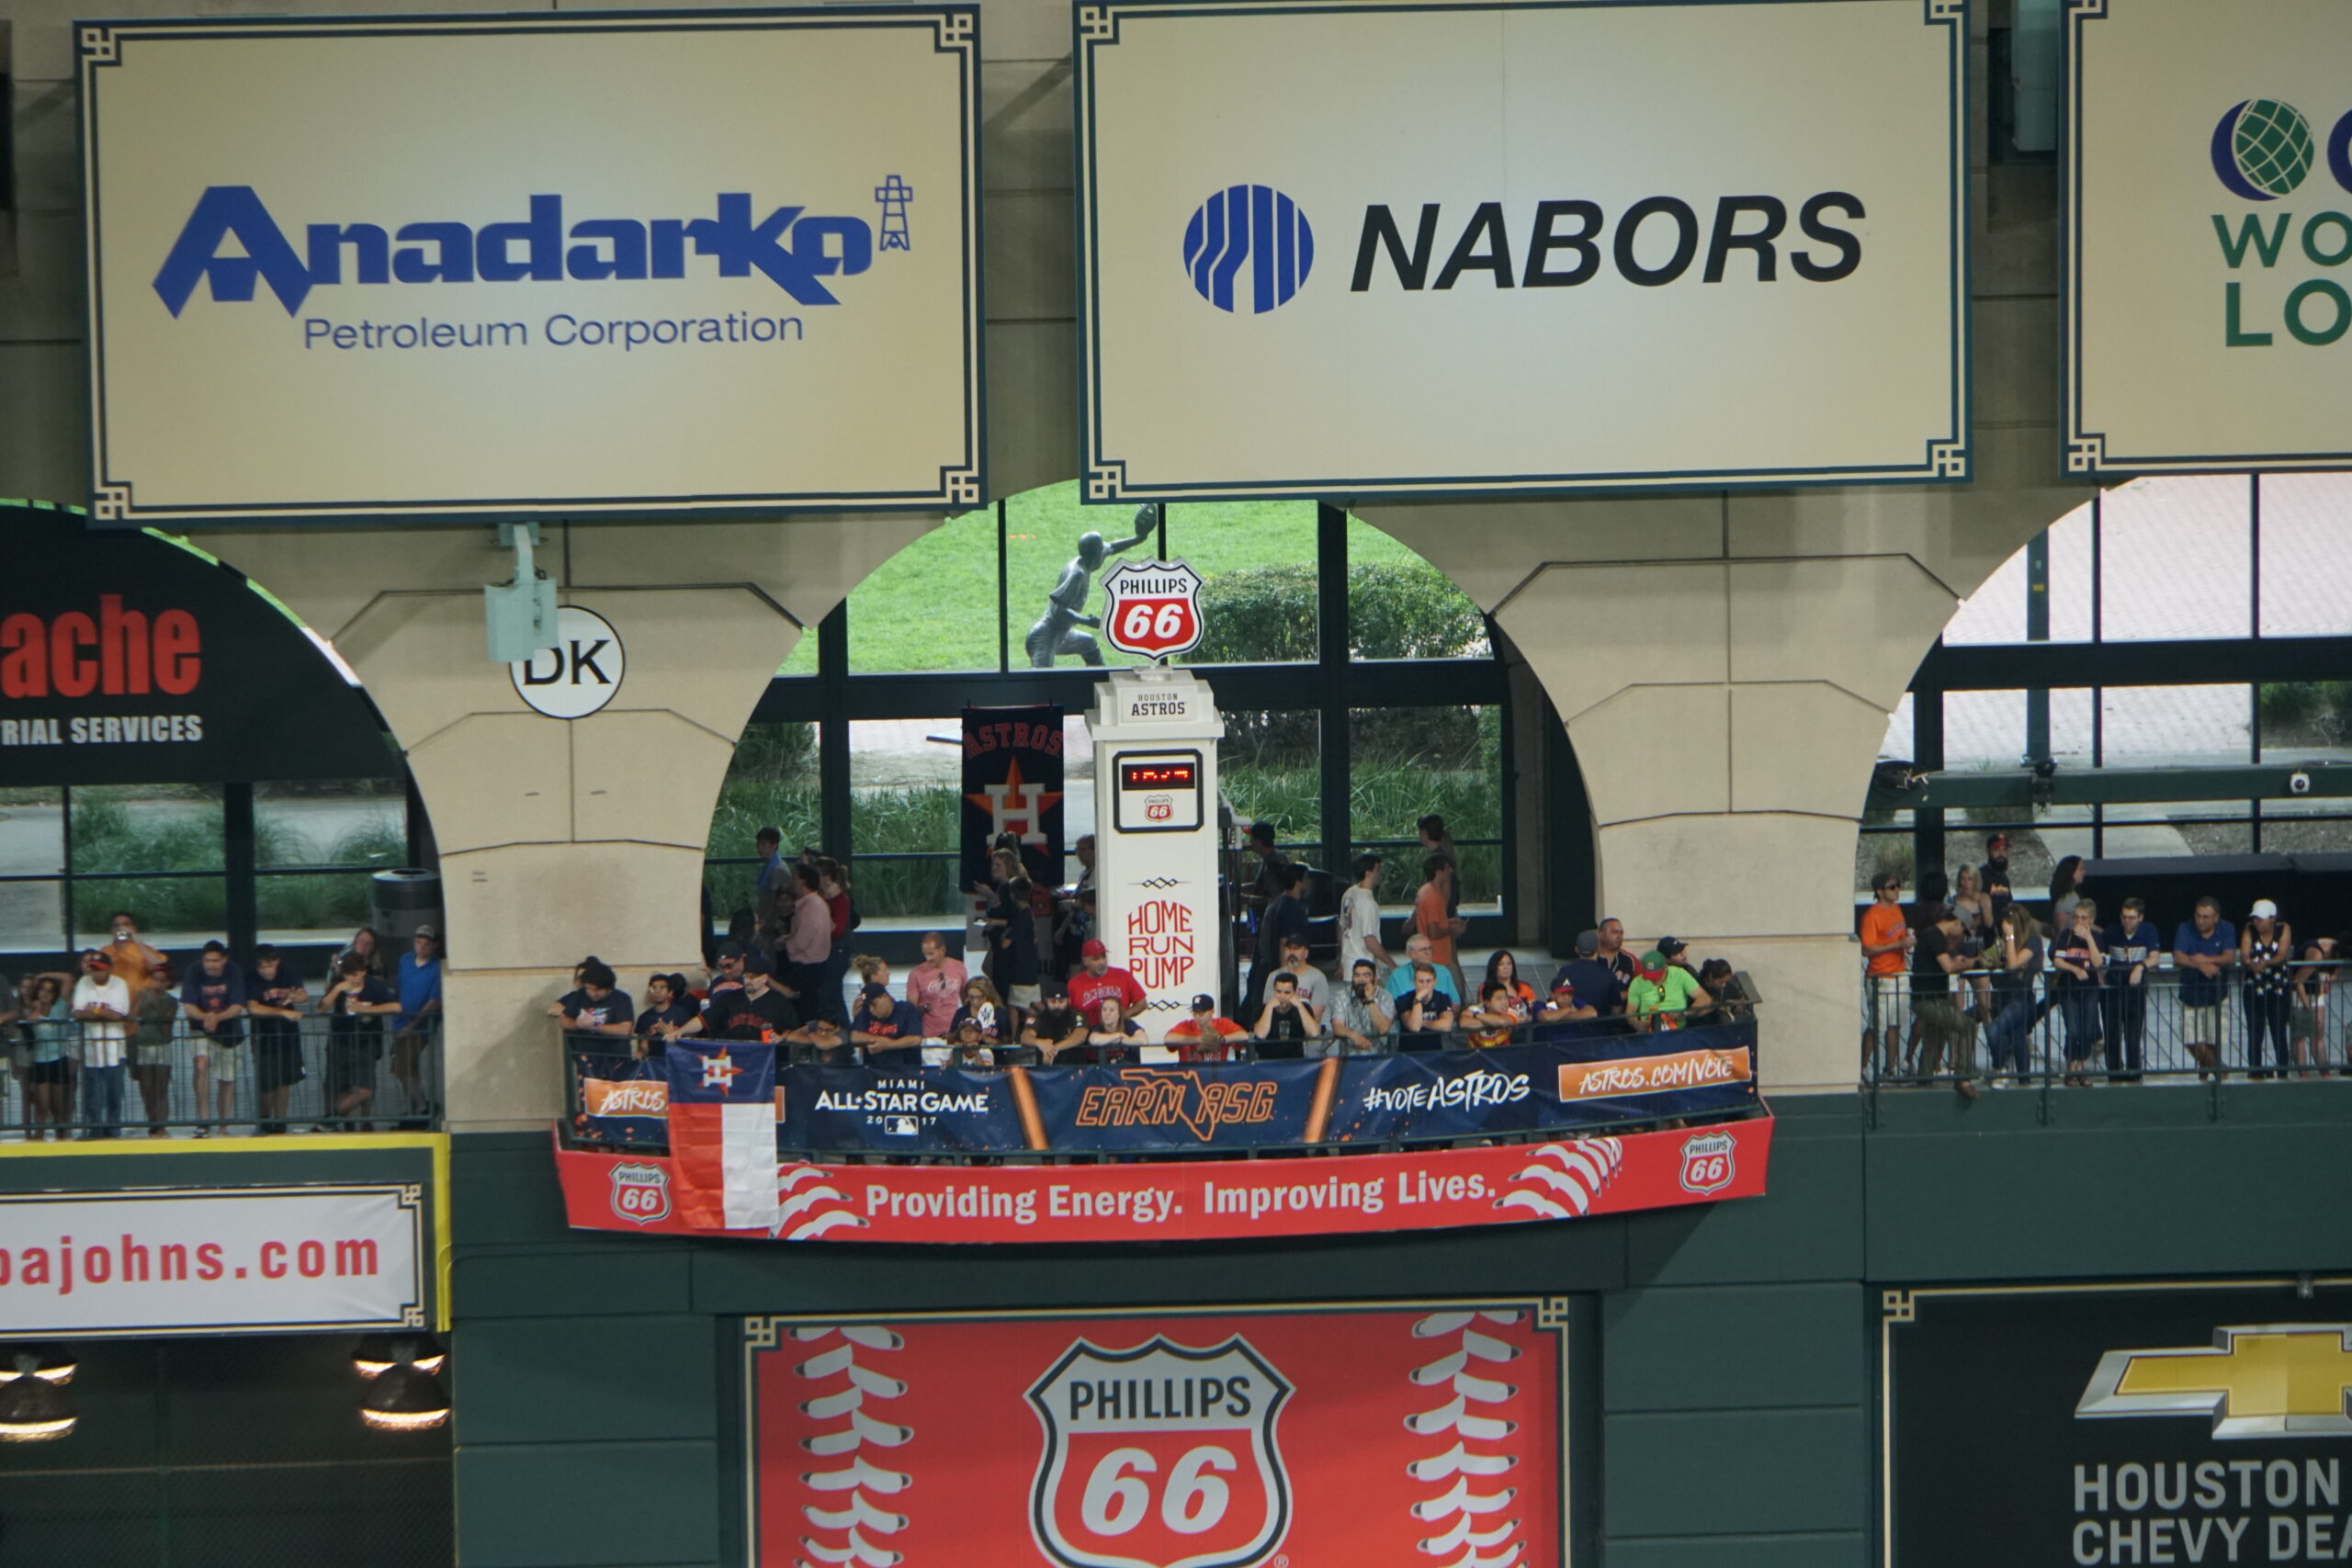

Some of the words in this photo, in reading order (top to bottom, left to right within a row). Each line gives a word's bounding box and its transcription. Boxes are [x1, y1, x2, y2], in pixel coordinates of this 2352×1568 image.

[152, 186, 873, 319] Anadarko
[1350, 190, 1867, 292] NABORS
[2210, 210, 2352, 269] WO
[303, 318, 528, 350] Petroleum
[544, 311, 805, 351] Corporation
[2224, 278, 2352, 348] LO
[1120, 577, 1188, 594] PHILLIPS
[1124, 604, 1184, 639] 66
[0, 593, 202, 699] ache
[523, 639, 613, 686] DK
[1131, 702, 1186, 716] ASTROS
[1137, 693, 1179, 702] HOUSTON
[0, 718, 63, 746] RIAL
[70, 715, 203, 745] SERVICES
[963, 722, 1064, 758] ASTROS
[1149, 805, 1170, 818] 66
[1127, 899, 1193, 936] HOME
[1128, 935, 1194, 956] RUN
[1129, 955, 1194, 989] PUMP
[876, 1078, 925, 1090] MIAMI
[1578, 1056, 1734, 1095] ASTROS.COM/VOTE
[921, 1092, 989, 1112] GAME
[1075, 1085, 1187, 1127] EARN
[1195, 1081, 1278, 1123] ASG
[1689, 1139, 1728, 1155] PHILLIPS
[617, 1169, 662, 1184] PHILLIPS
[1690, 1156, 1724, 1182] 66
[622, 1188, 660, 1212] 66
[865, 1184, 1038, 1224] Providing
[1048, 1184, 1183, 1223] Energy.
[1204, 1176, 1385, 1220] Improving
[1398, 1169, 1497, 1204] Lives.
[1069, 1376, 1252, 1421] PHILLIPS
[1081, 1445, 1238, 1537] 66
[2074, 1458, 2340, 1512] HOUSTON
[2072, 1516, 2251, 1566] CHEVY
